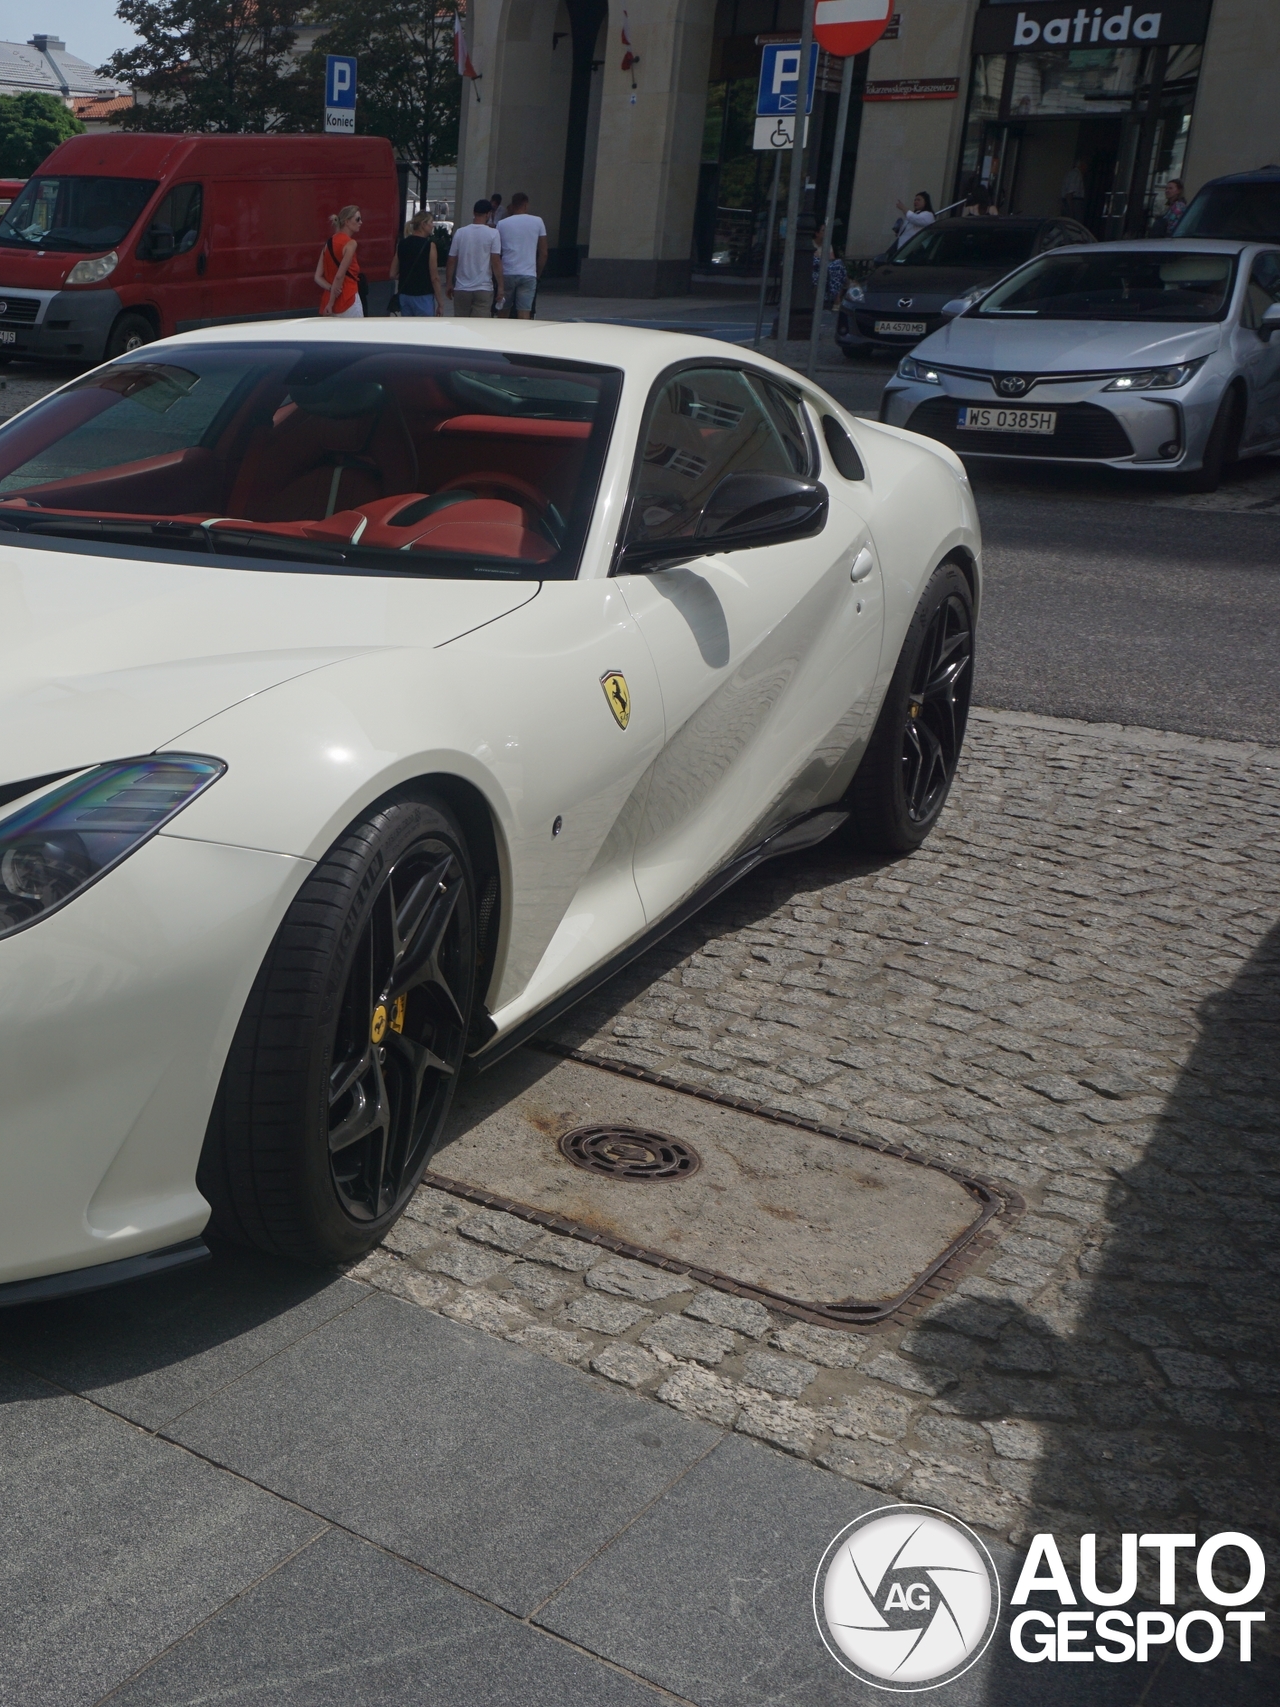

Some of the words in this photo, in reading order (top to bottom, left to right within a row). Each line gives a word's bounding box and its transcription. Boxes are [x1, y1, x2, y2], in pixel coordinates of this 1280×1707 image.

[1013, 5, 1162, 46] batida
[333, 61, 351, 101] P
[771, 50, 802, 94] P
[326, 113, 354, 127] Koniec
[880, 323, 891, 331] AA
[892, 323, 911, 332] 4570
[969, 409, 991, 426] WS
[997, 411, 1052, 430] 0385H
